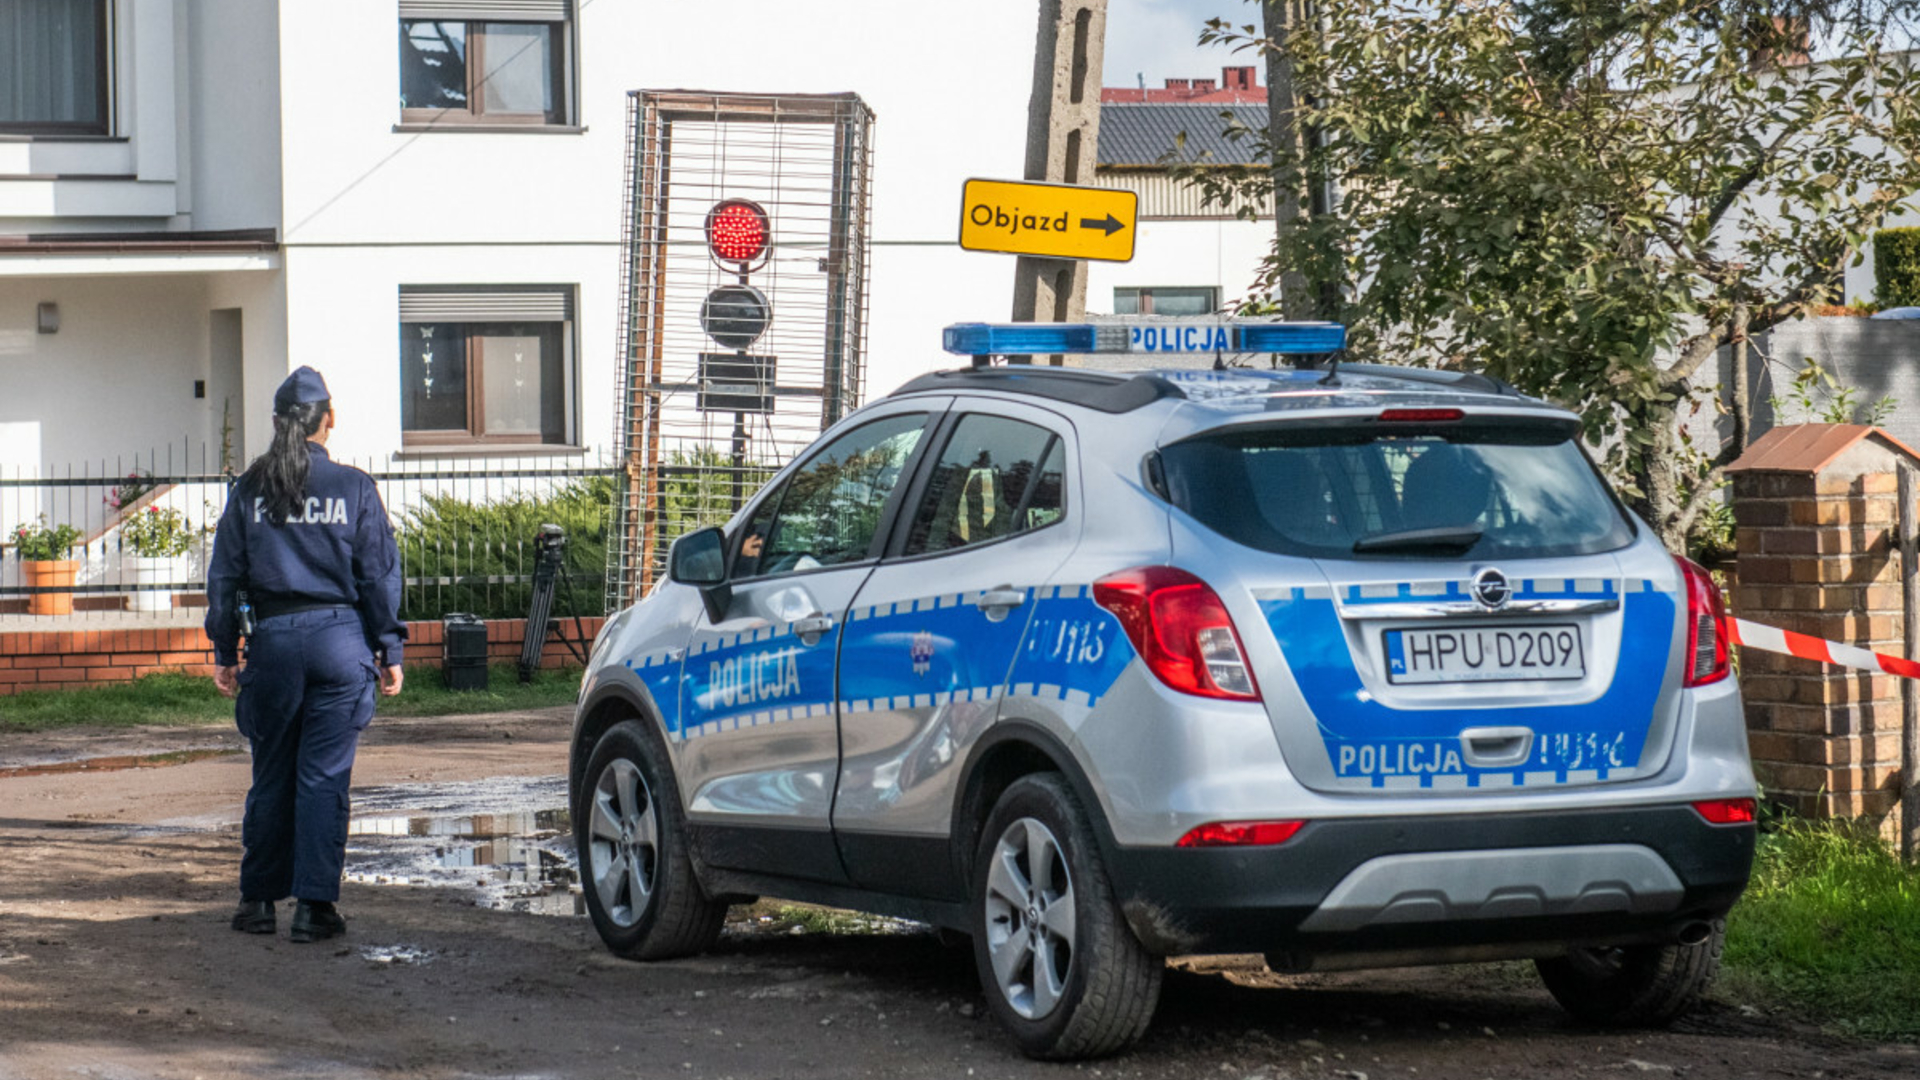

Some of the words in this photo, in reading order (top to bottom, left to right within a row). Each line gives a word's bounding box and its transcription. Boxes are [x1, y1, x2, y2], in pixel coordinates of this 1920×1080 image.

[971, 204, 1068, 235] Objazd
[1132, 326, 1229, 353] POLICJA
[253, 496, 348, 524] PCJA
[1391, 659, 1404, 669] PL
[1409, 631, 1484, 670] HPU
[1496, 631, 1574, 668] D209
[709, 646, 801, 711] POLICJA
[1339, 743, 1462, 775] POLICJA
